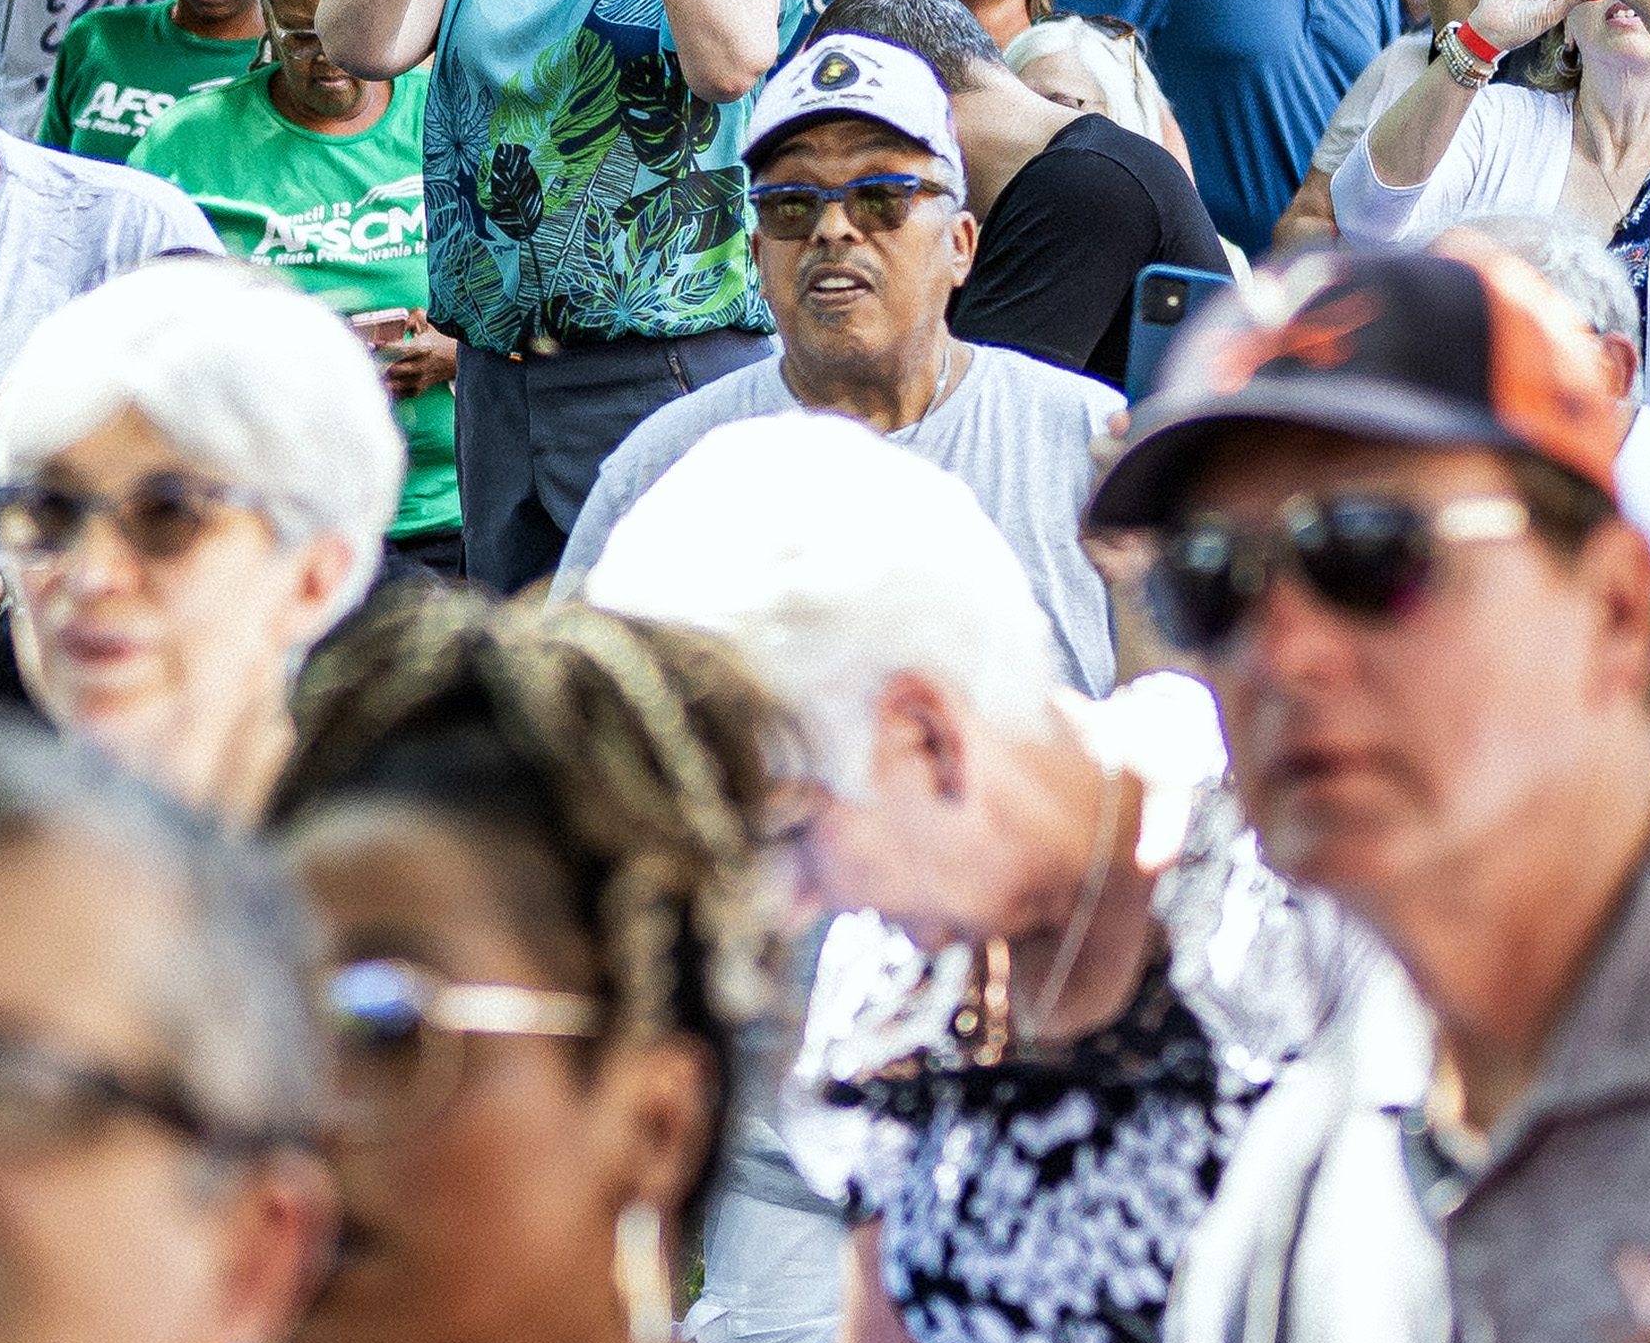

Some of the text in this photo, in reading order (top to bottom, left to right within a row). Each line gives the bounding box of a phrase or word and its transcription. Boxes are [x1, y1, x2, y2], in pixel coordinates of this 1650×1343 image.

[79, 80, 178, 127] AFS
[252, 201, 428, 255] AFSCM
[331, 201, 353, 220] 13
[274, 251, 315, 267] Make
[414, 239, 428, 256] H
